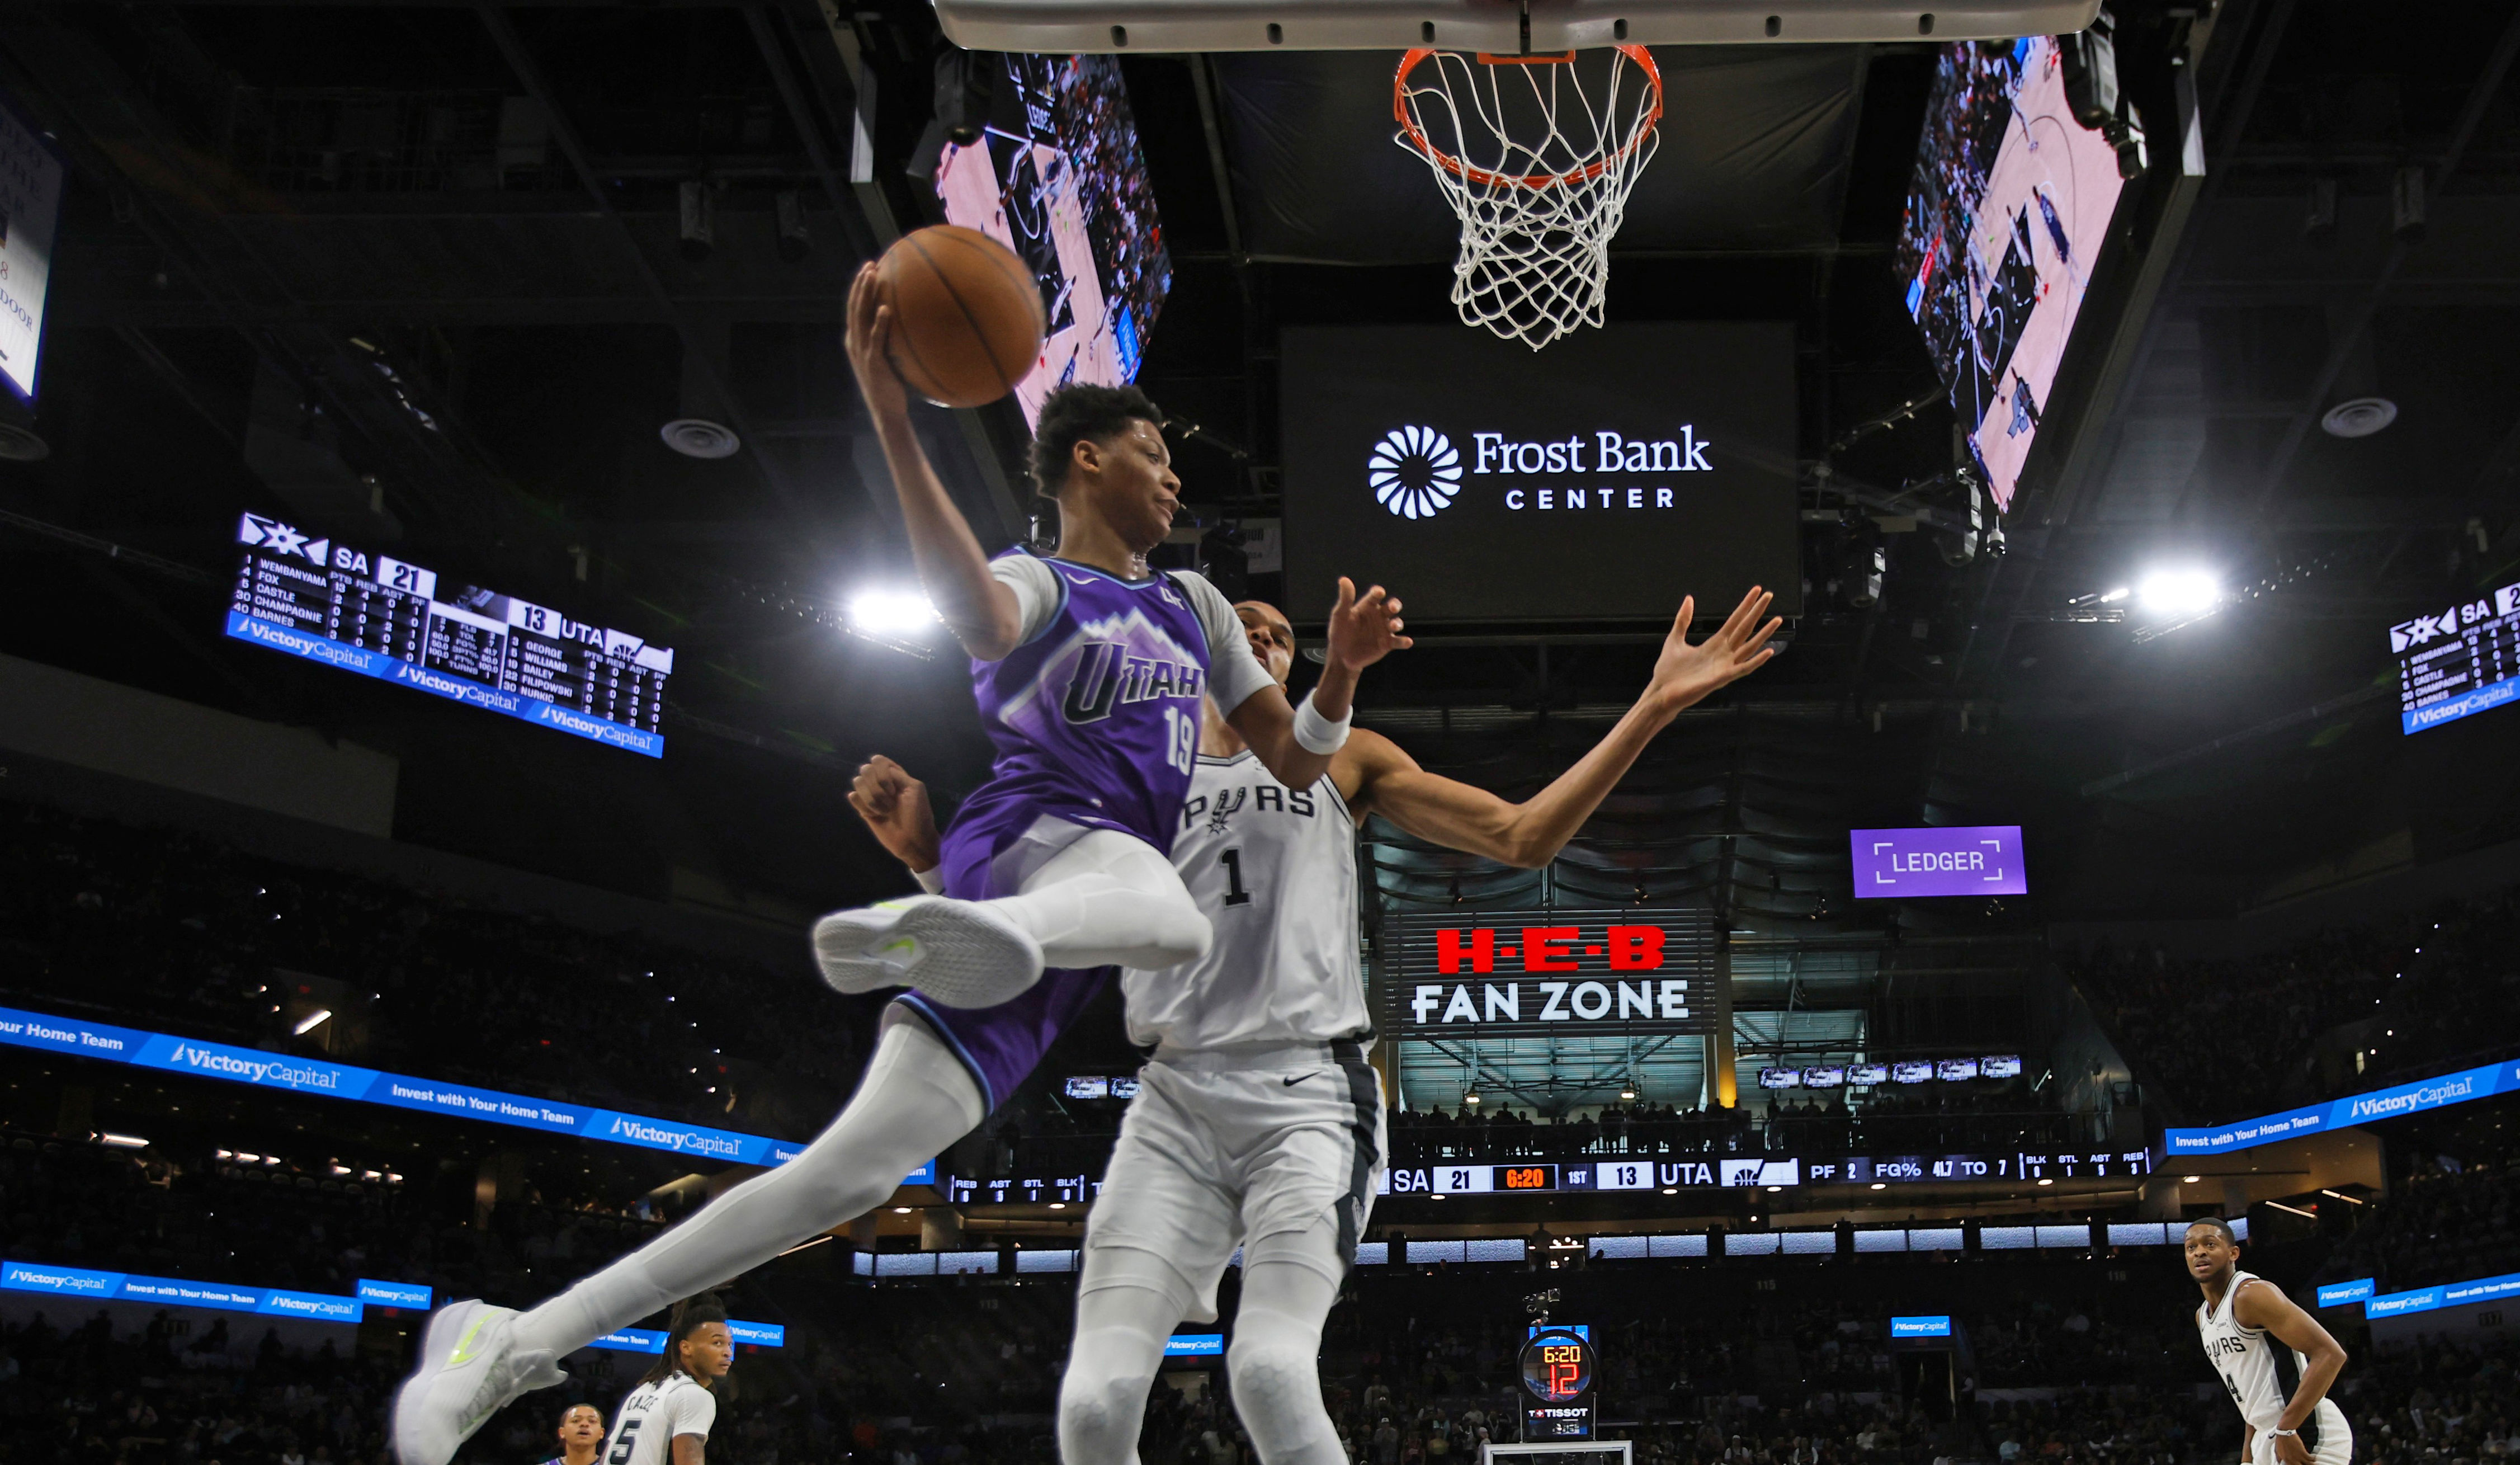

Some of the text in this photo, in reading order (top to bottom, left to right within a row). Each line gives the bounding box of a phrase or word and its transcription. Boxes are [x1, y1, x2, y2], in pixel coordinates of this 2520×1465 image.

[1473, 425, 1713, 474] Frost Bank
[1506, 488, 1674, 510] CENTER
[243, 567, 251, 576] 4
[258, 571, 279, 585] FOX
[247, 554, 251, 564] 1
[261, 558, 327, 587] WEMBANYAMA
[336, 548, 418, 592] SA 21
[257, 583, 295, 602] CASTLE
[234, 602, 249, 614] 40
[253, 607, 294, 627] BARNES
[236, 589, 251, 601] 30
[255, 595, 322, 623] CHAMPAGNIE
[2461, 599, 2491, 624] SA
[525, 605, 604, 648] 13 UTA
[525, 652, 568, 673] WILLIAMS
[526, 640, 563, 660] GEORGE
[523, 663, 554, 680] BAILEY
[1064, 641, 1205, 725] UTAH
[251, 621, 653, 750] VictoryCapital VictoryCapital VictoryCapital
[521, 685, 554, 704] NURKIC
[522, 674, 573, 698] FILIPOWSKI
[2418, 682, 2515, 724] VictoryCapital
[1164, 705, 1195, 776] 19
[1185, 785, 1315, 834] PURS
[1893, 851, 1984, 872] LEDGER
[1220, 846, 1253, 908] 1
[1411, 980, 1689, 1024] FAN ZONE
[0, 1021, 926, 1177] our Home Team VictoryCapital Invest with Your Home Team VictoryCapital Inve am
[2175, 1076, 2472, 1147] Invest with Your Home Team VictoryCapital
[2026, 1152, 2144, 1164] BLK STL AST REB
[2066, 1165, 2071, 1176] 1
[956, 1180, 977, 1189] REB
[1024, 1179, 1044, 1188] STL
[1057, 1179, 1078, 1187] BLK
[1394, 1170, 1429, 1192] SA
[1452, 1171, 1470, 1190] 21
[1507, 1169, 1544, 1188] 6:20
[1568, 1171, 1587, 1184] 1ST
[1616, 1167, 1637, 1186] 13
[1660, 1163, 1713, 1185] UTA
[1811, 1165, 1835, 1179] PF
[1848, 1163, 1856, 1179] 2
[1875, 1163, 1922, 1177] FG%
[1961, 1161, 1987, 1175] TO
[1998, 1160, 2006, 1175] 7
[18, 1271, 354, 1315] VictoryCapital Invest with Your Home Team VictoryCapital
[367, 1288, 427, 1302] VictoryCapital
[2376, 1293, 2433, 1311] VictoryCapital
[607, 1334, 649, 1345] Home Team
[732, 1327, 780, 1339] VictoryCapital
[1899, 1322, 1947, 1332] VictoryCapital
[1171, 1340, 1220, 1350] VictoryCapital
[1544, 1346, 1581, 1363] 6:20
[2206, 1337, 2247, 1368] PURS
[1550, 1364, 1579, 1395] 12
[2226, 1372, 2243, 1402] 4
[1545, 1408, 1588, 1417] TISSOT
[610, 1417, 642, 1465] 5
